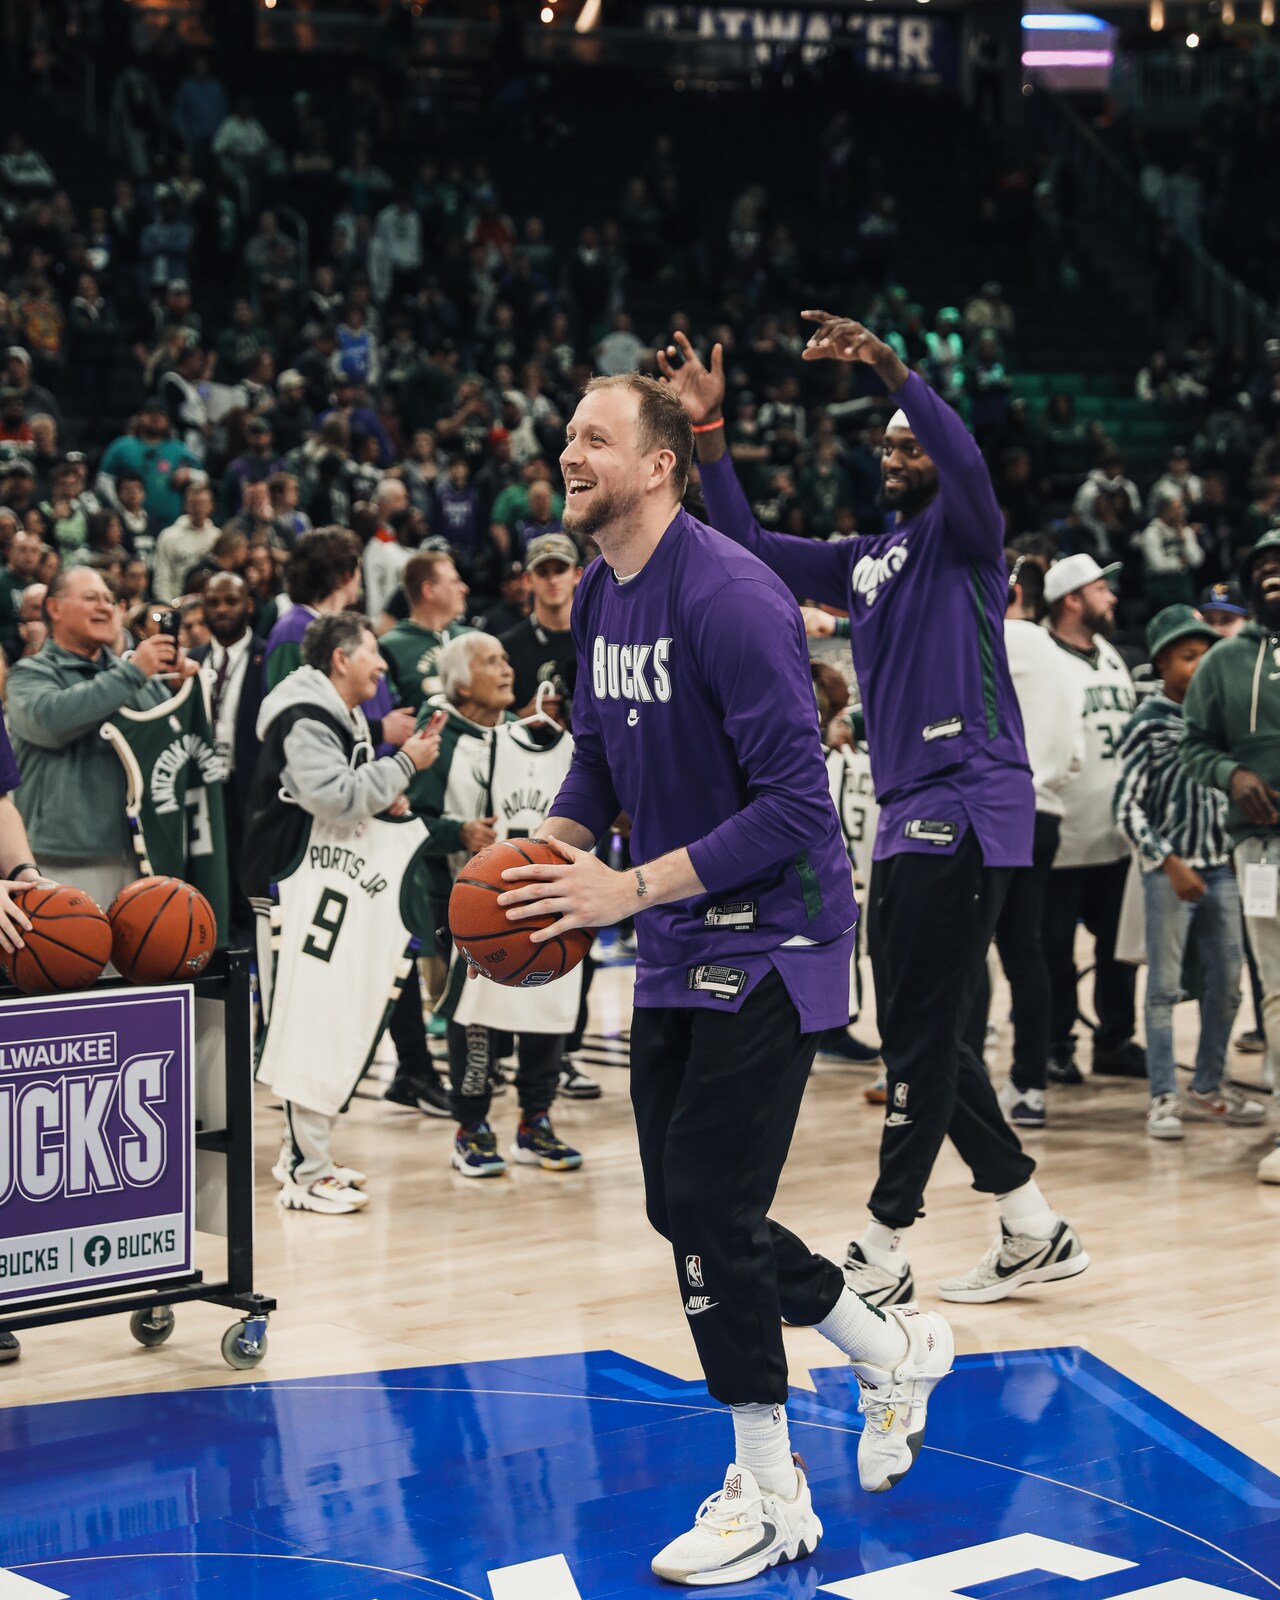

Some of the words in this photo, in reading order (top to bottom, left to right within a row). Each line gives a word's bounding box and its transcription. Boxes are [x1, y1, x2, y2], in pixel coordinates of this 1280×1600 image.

[592, 635, 673, 703] BUCKS
[310, 845, 365, 880] PORTIS
[360, 872, 388, 899] JR
[302, 887, 348, 963] 9
[0, 1246, 58, 1278] BUCKS
[117, 1229, 175, 1259] BUCKS
[688, 1295, 711, 1309] NIKE
